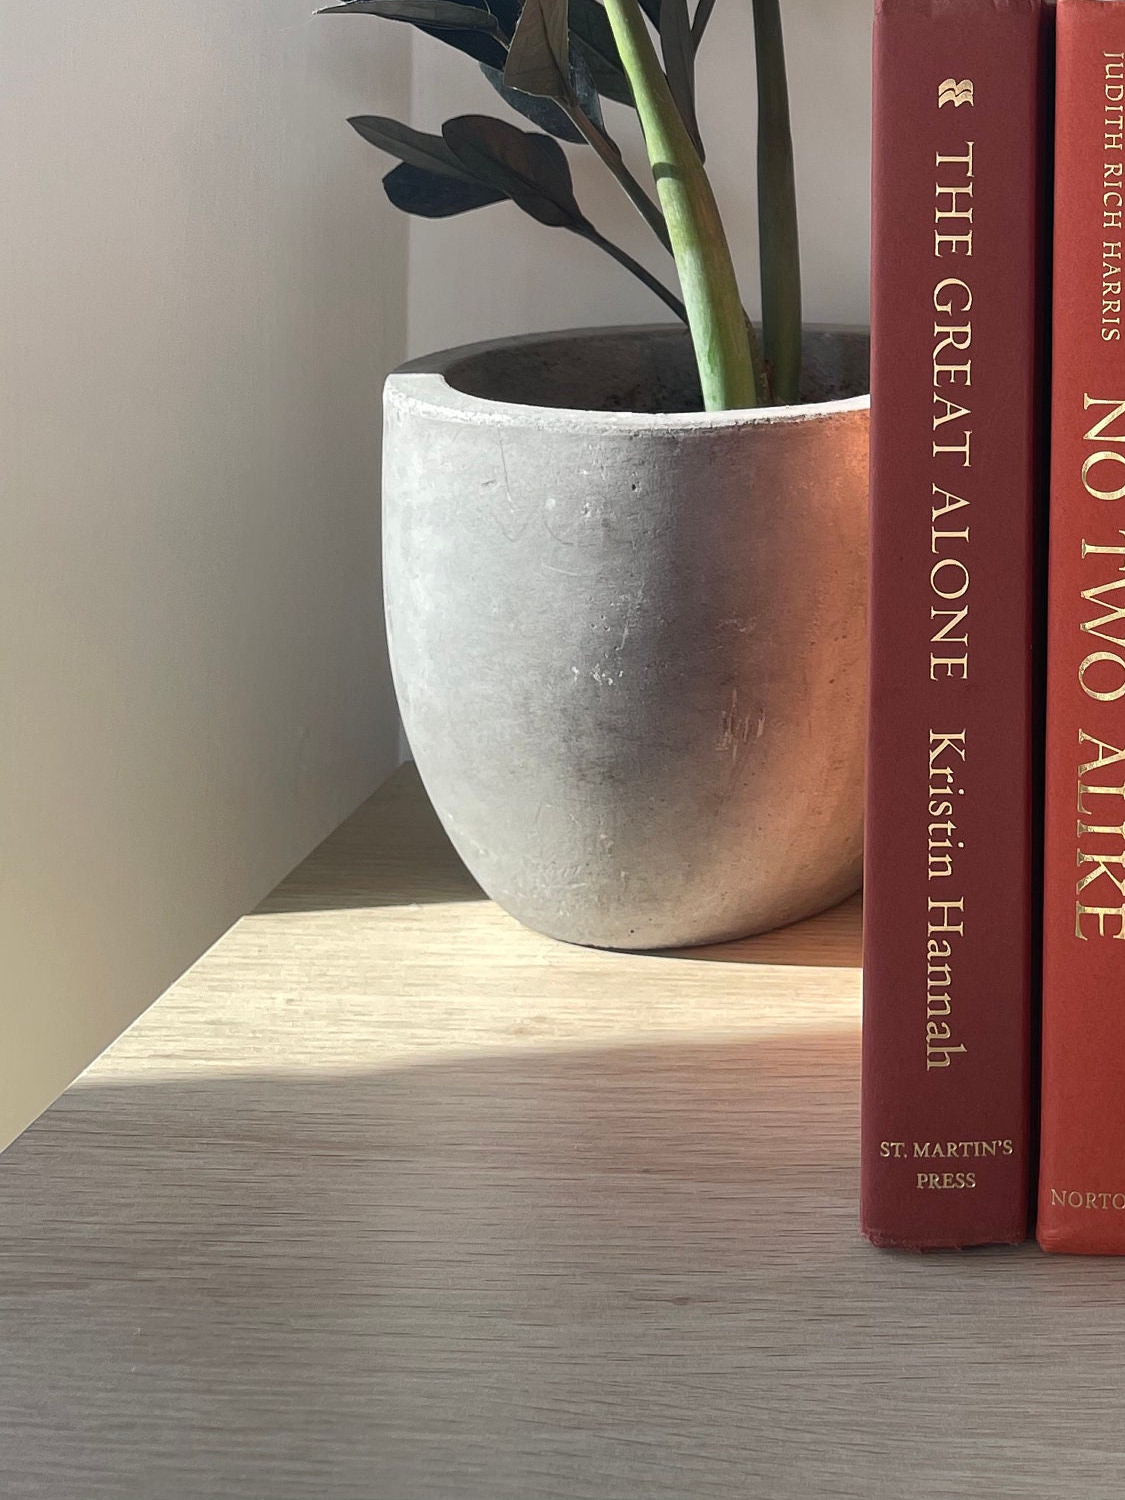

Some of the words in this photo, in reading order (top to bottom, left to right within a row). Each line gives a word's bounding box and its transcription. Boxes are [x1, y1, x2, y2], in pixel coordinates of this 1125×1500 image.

[1102, 51, 1125, 151] JUDITH
[933, 140, 976, 259] THE
[1102, 162, 1123, 229] RICH
[1101, 241, 1122, 342] HARRIS
[932, 277, 974, 468] GREAT
[929, 482, 971, 682] ALONE
[927, 727, 967, 881] Kristin
[925, 895, 968, 1072] Hannah
[879, 1141, 908, 1159] ST.
[912, 1139, 1013, 1159] MARTIN'S
[916, 1172, 977, 1190] PRESS
